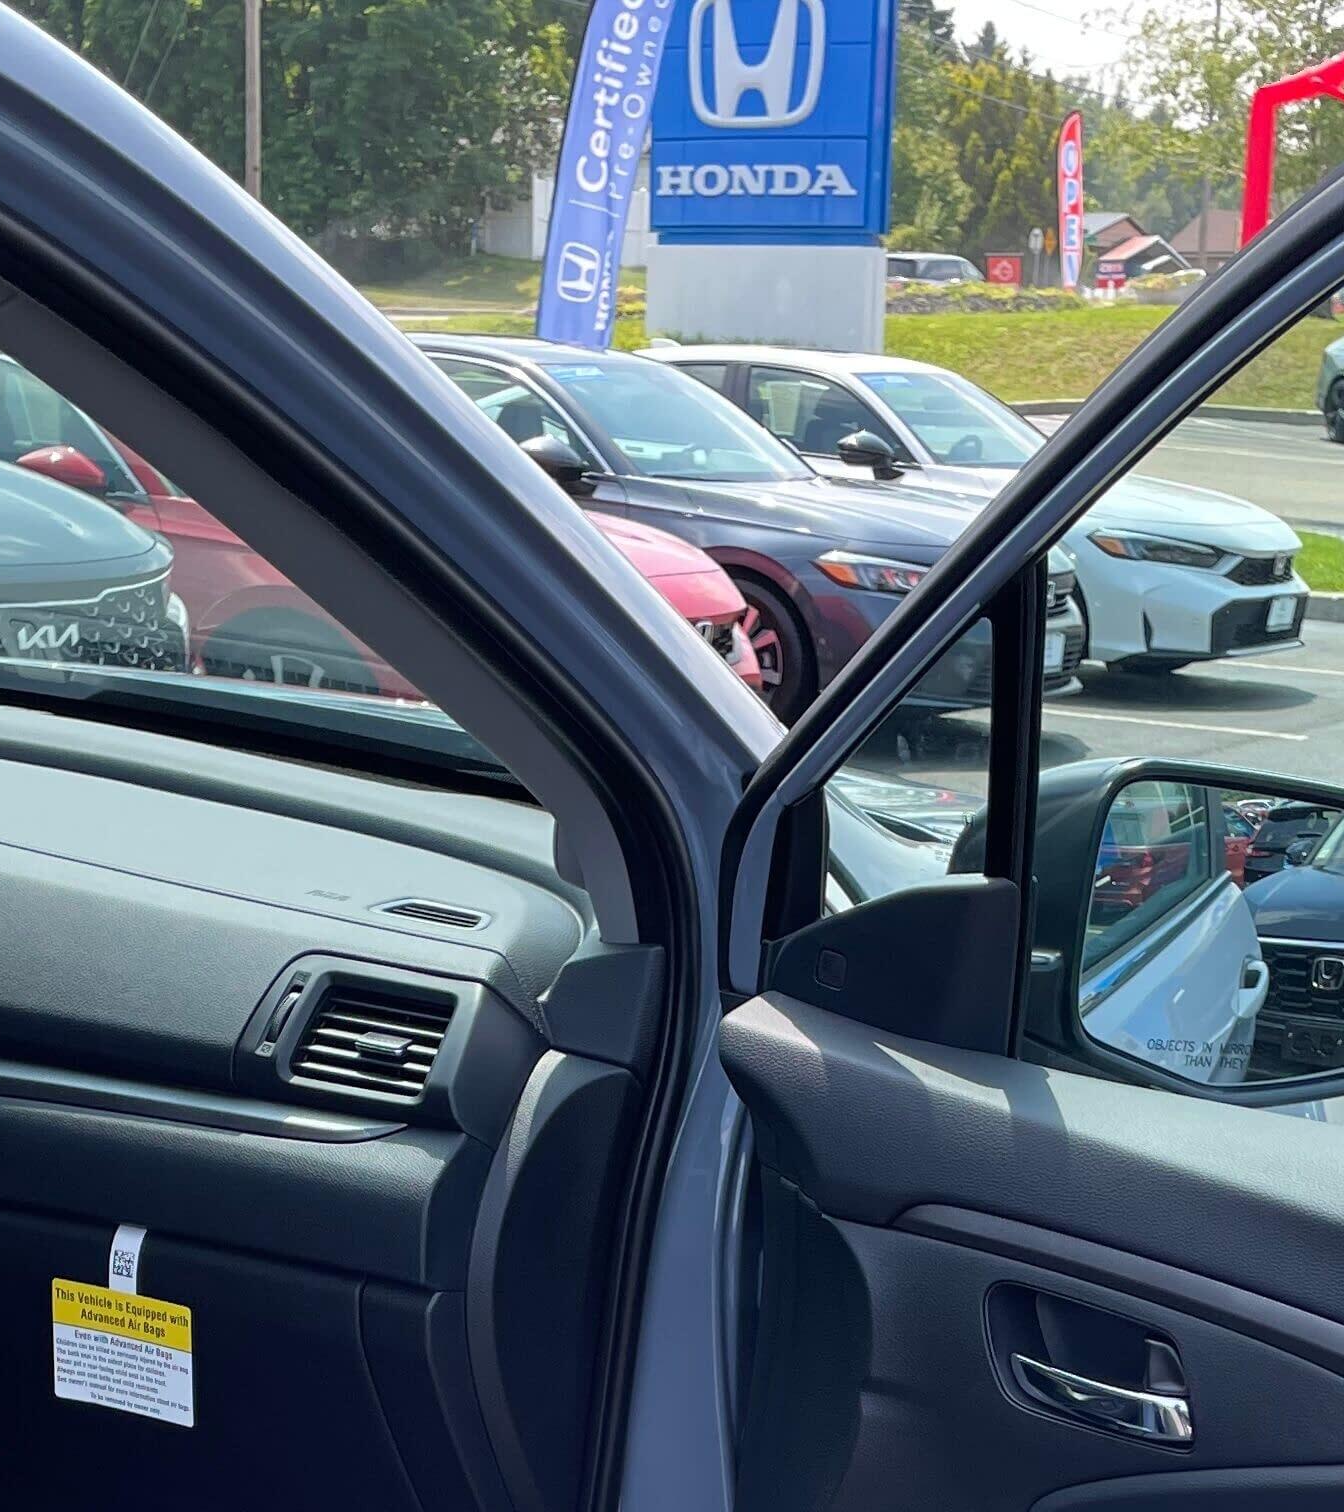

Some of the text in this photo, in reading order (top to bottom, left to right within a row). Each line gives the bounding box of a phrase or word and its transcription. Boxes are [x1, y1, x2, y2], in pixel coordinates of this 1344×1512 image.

[656, 164, 858, 197] HONDA
[1147, 1038, 1258, 1056] OBJECTS IN MIRRO
[1184, 1055, 1246, 1069] THAN THEY
[55, 1287, 189, 1328] This Vehicle is Equipped with
[80, 1308, 166, 1339] Advanced Air Bags
[110, 1336, 143, 1353] Advanced
